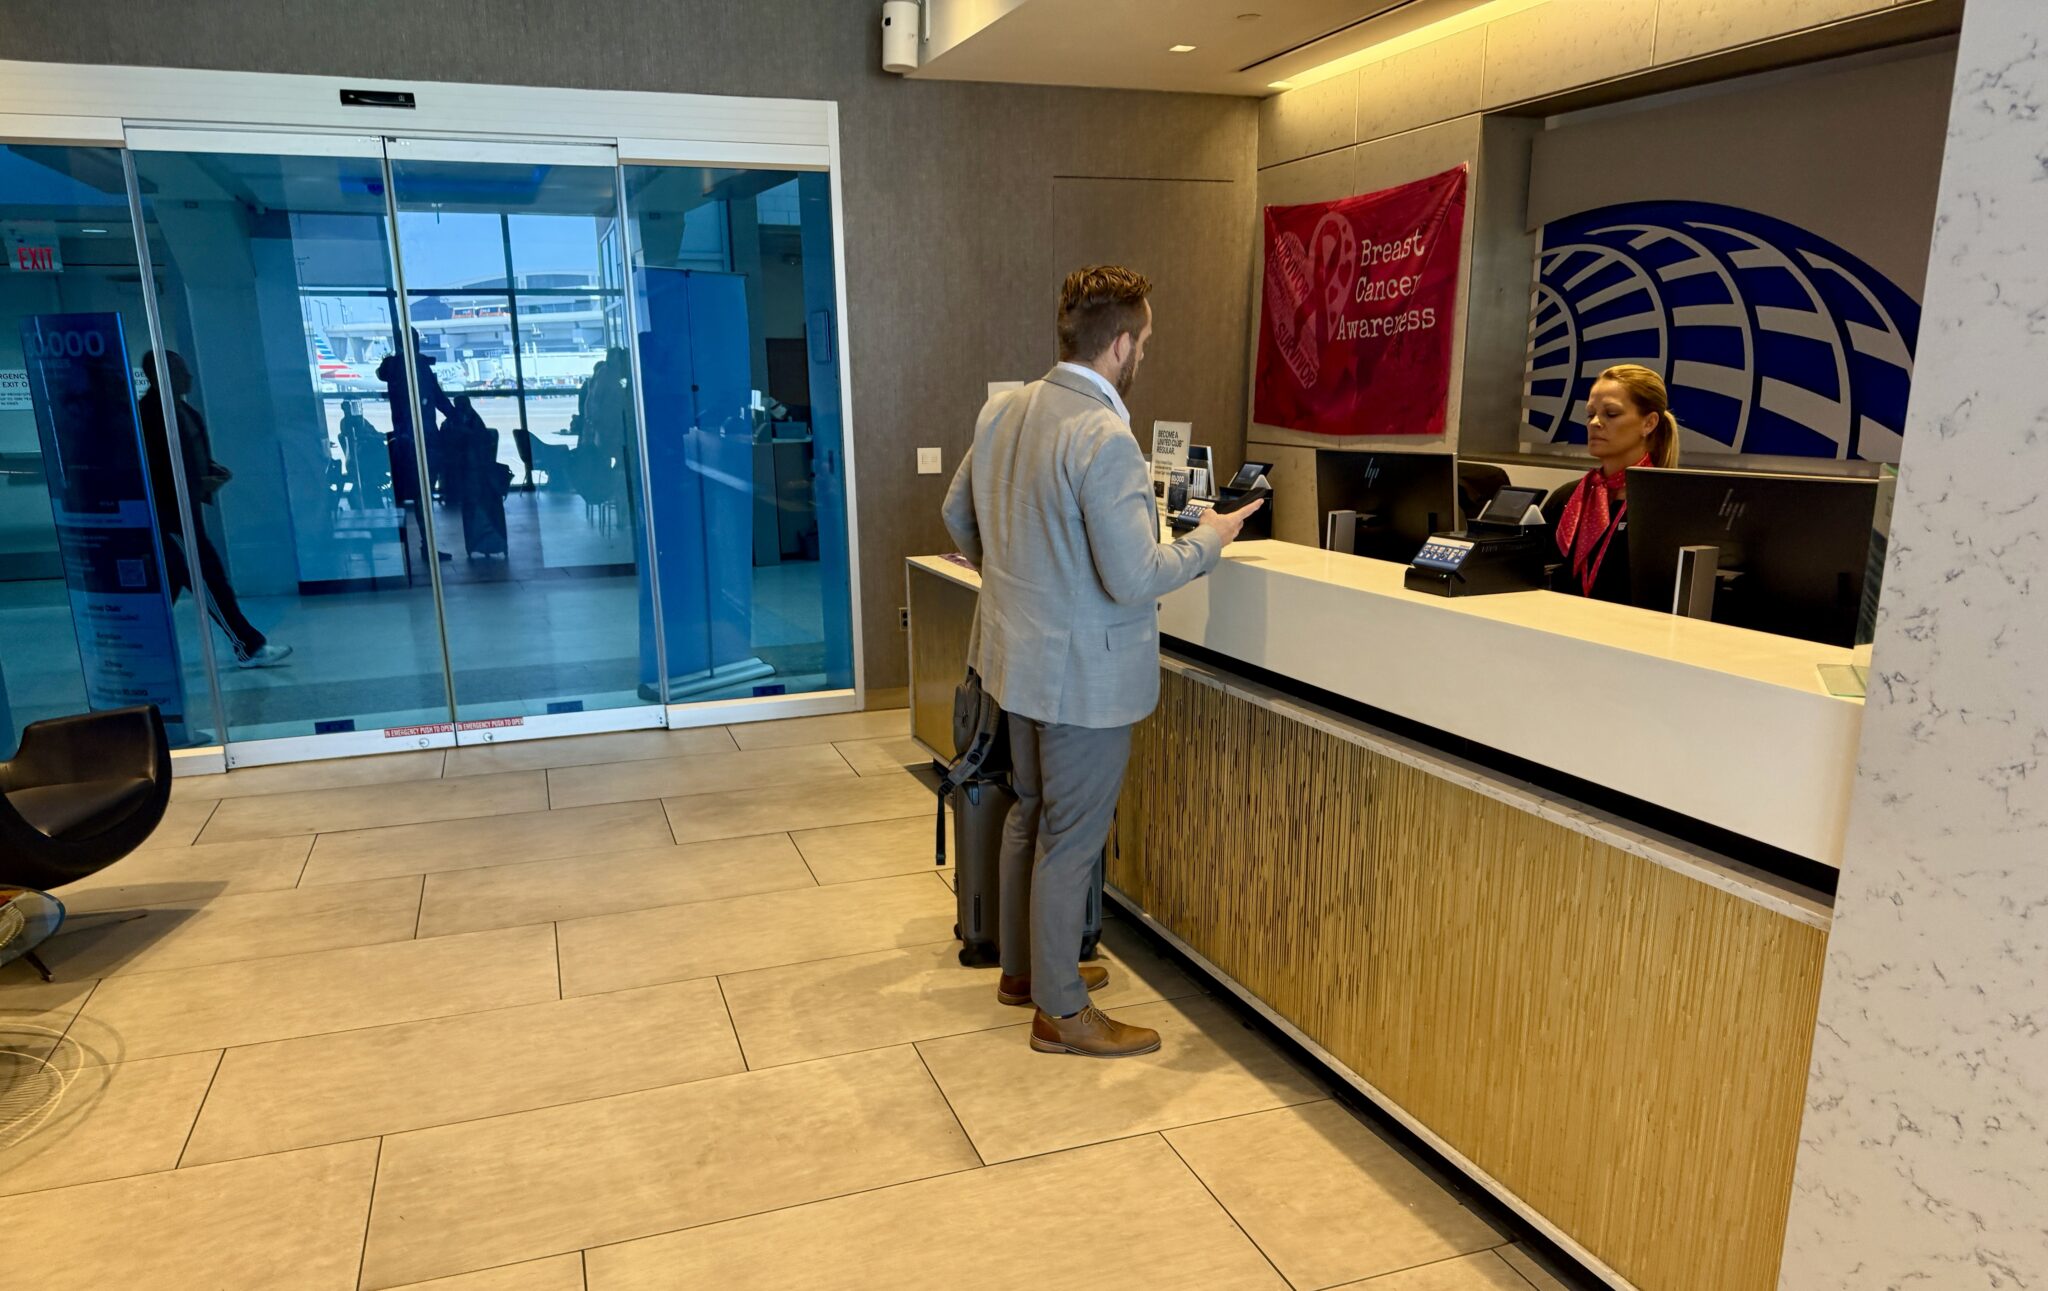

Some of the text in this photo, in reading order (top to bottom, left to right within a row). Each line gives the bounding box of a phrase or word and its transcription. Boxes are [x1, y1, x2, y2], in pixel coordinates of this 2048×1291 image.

[17, 247, 53, 271] EXIT
[1360, 228, 1425, 267] Breast
[1355, 274, 1422, 303] Cancer
[1277, 322, 1317, 388] SURVIVOR
[1157, 430, 1175, 439] BECOME
[390, 728, 419, 737] EMERGENCY
[433, 725, 440, 733] TO
[463, 720, 491, 730] EMERGENCY
[491, 719, 504, 728] PUSH
[504, 719, 511, 727] TO
